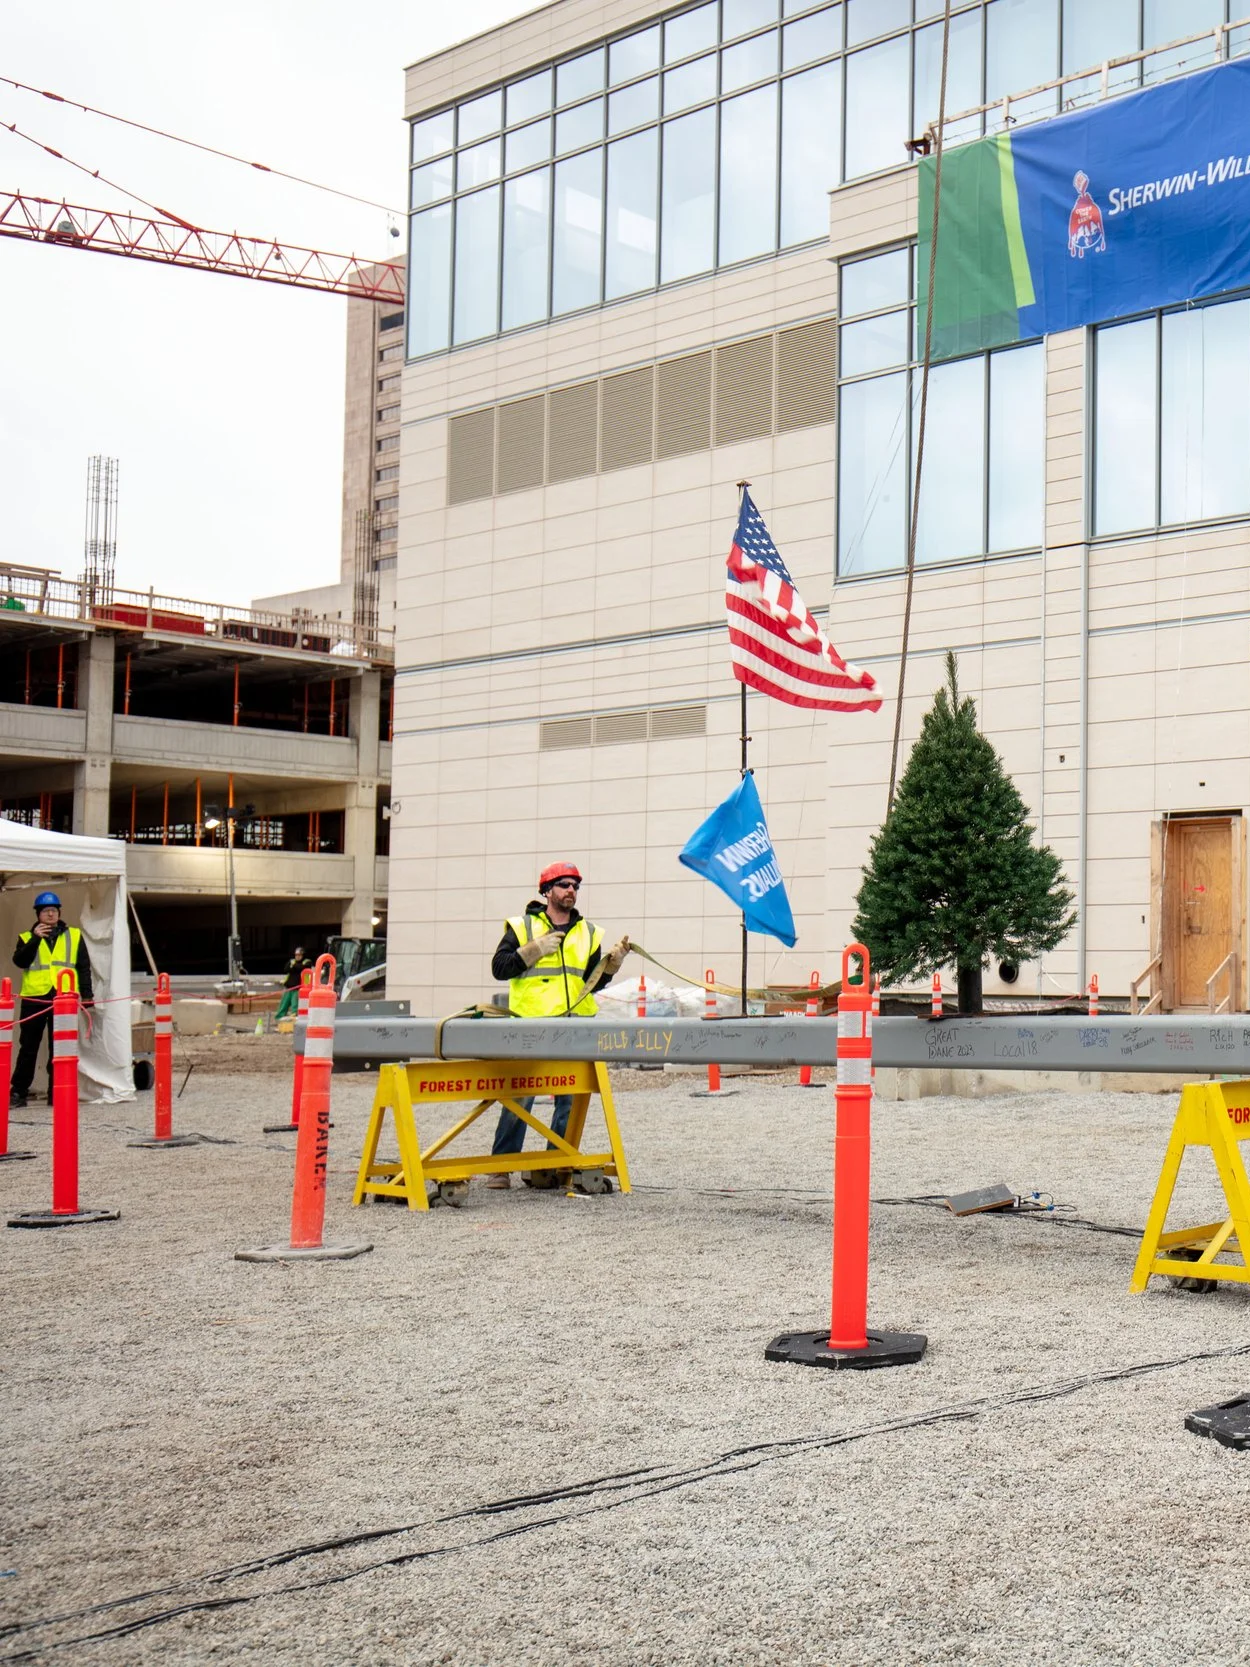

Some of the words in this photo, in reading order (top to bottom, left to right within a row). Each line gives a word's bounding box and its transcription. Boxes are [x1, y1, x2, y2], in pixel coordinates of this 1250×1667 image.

[925, 1027, 960, 1046] GREAT
[928, 1045, 955, 1059] DANE
[420, 1079, 472, 1093] FOREST
[477, 1077, 505, 1091] CITY
[511, 1074, 577, 1090] ERECTORS
